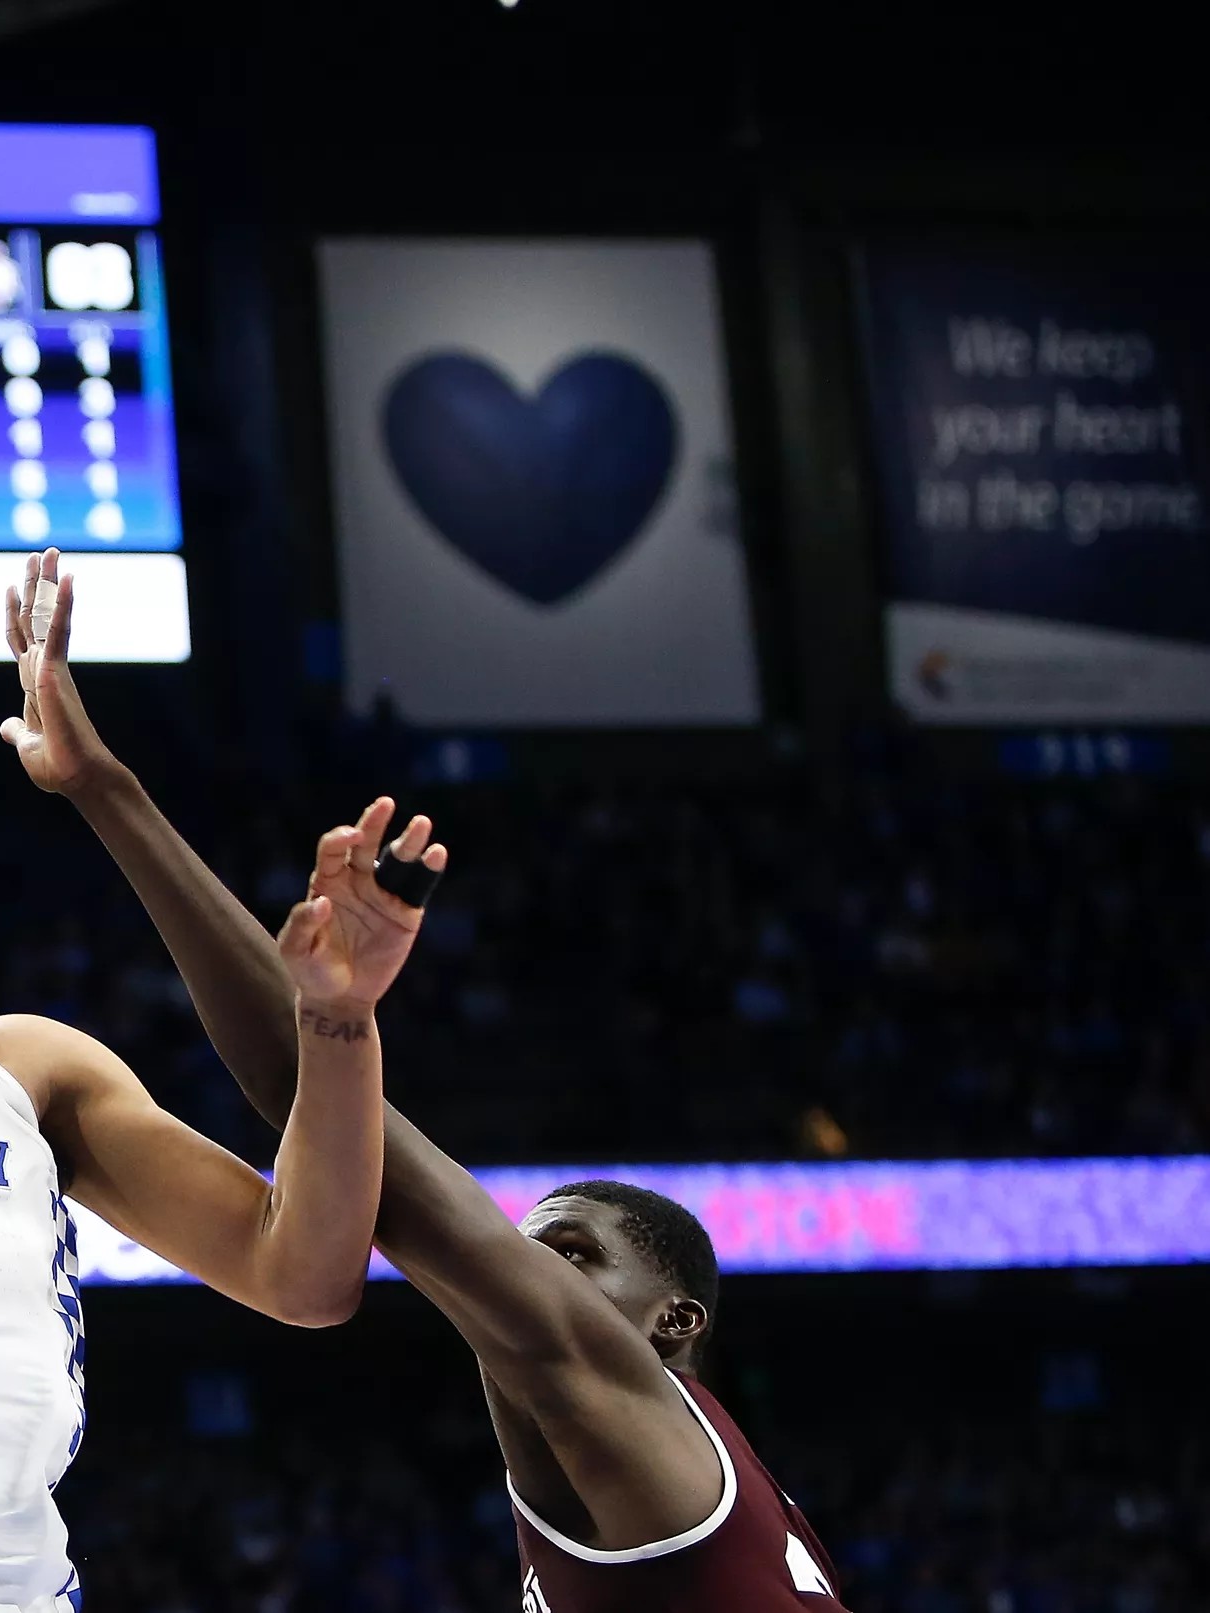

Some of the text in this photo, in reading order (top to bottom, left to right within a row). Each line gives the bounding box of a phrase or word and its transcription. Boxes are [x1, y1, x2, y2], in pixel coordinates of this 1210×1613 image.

[948, 315, 1155, 384] We keep
[932, 390, 1182, 468] your heart
[976, 470, 1057, 532] the
[1063, 480, 1198, 546] game
[300, 1008, 370, 1045] FEAR
